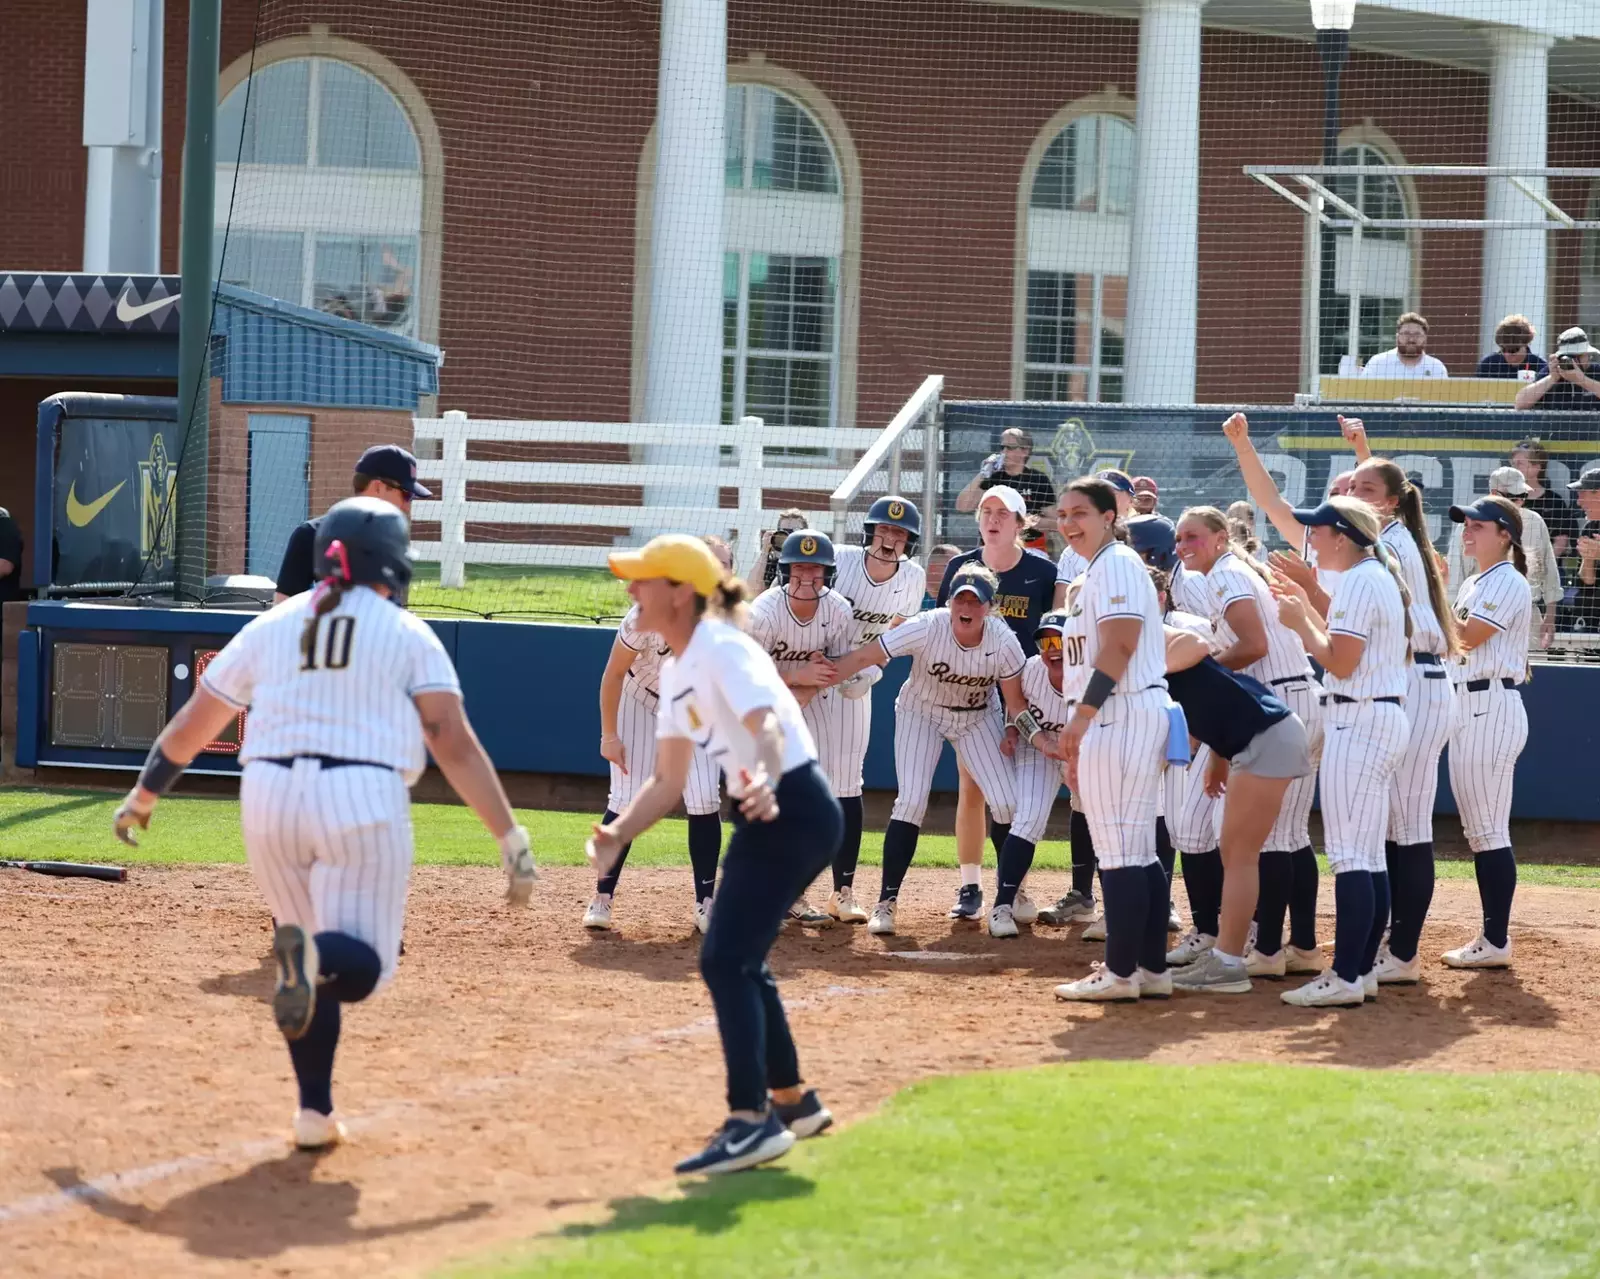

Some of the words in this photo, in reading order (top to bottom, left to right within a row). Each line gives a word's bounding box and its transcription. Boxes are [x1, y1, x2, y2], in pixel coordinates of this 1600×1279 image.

[999, 607, 1028, 619] BALL
[928, 661, 998, 687] Racers
[1028, 704, 1065, 734] Rac
